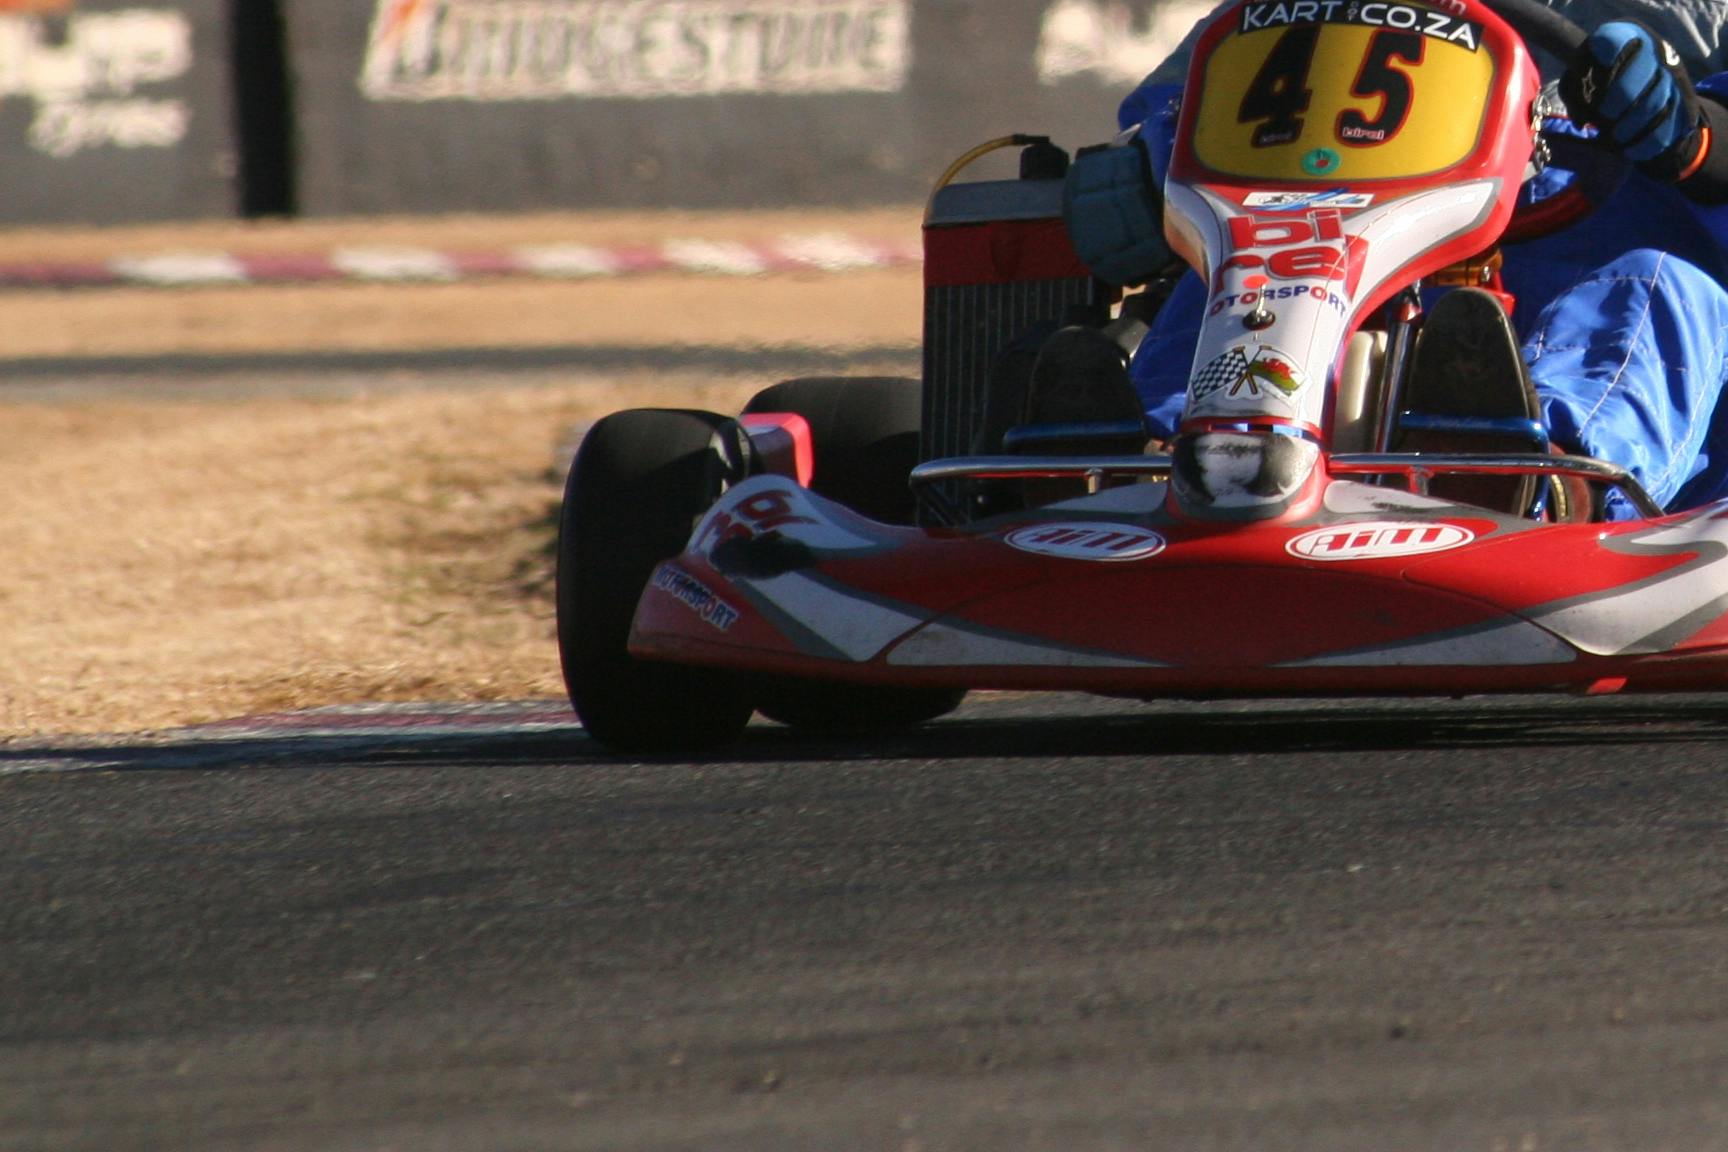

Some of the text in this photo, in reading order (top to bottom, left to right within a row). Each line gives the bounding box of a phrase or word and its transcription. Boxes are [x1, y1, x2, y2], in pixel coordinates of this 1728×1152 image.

[1242, 0, 1343, 32] KART
[1360, 3, 1477, 51] CO.ZA
[1237, 21, 1427, 148] 45
[1209, 284, 1347, 317] OTORSPORT
